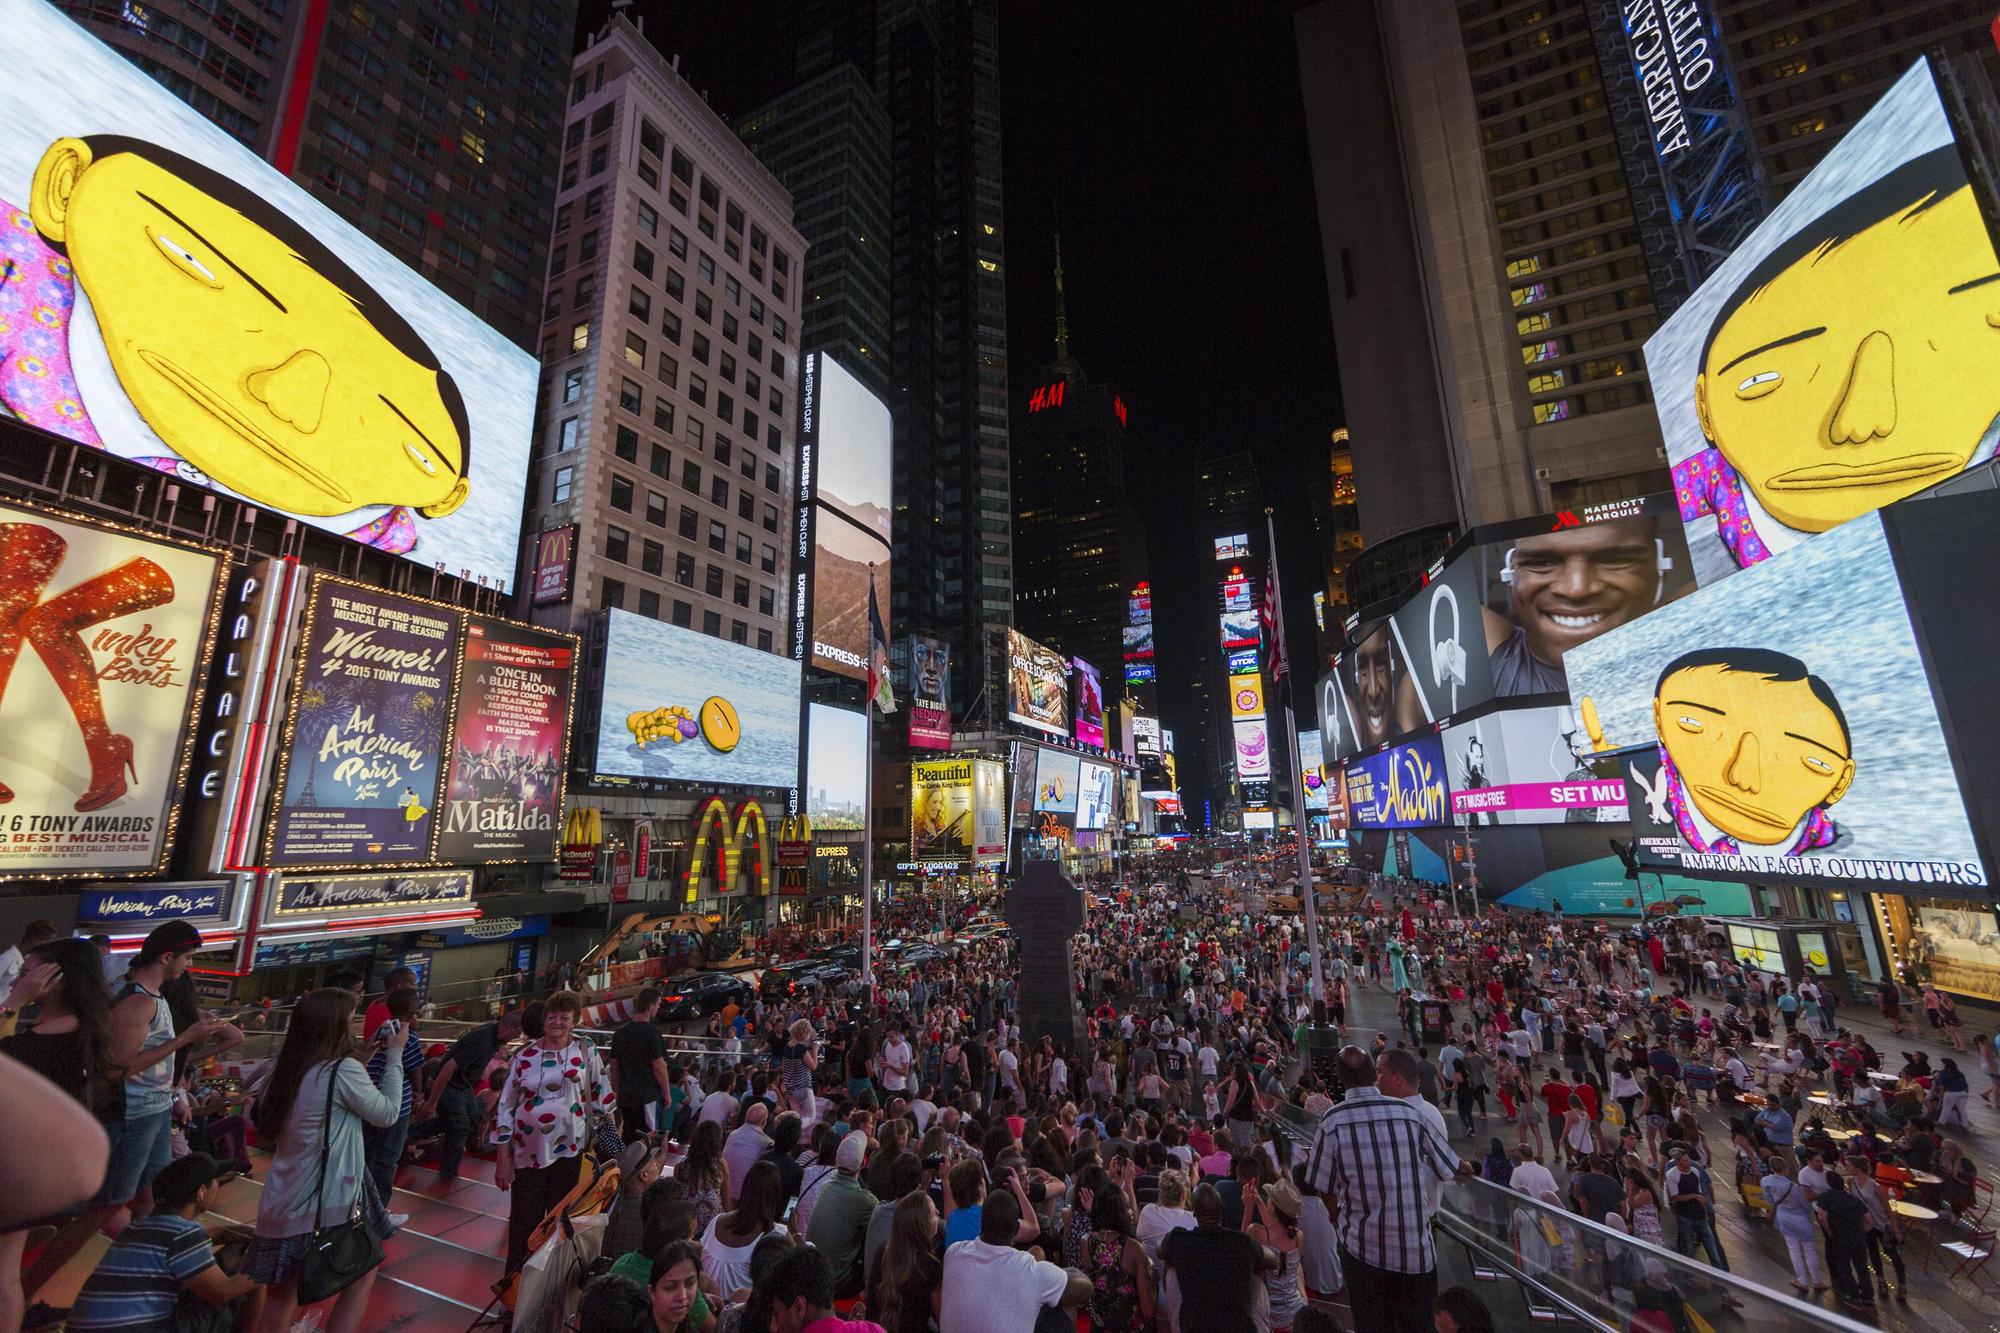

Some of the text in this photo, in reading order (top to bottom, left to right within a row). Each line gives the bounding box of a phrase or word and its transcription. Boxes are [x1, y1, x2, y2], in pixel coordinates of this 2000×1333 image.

[1624, 0, 1691, 156] AMERICAN
[1584, 498, 1646, 514] MARRIOTT
[1586, 507, 1640, 522] MARQUIS
[541, 564, 565, 576] OPEN
[542, 574, 560, 588] 24
[536, 586, 564, 598] HOURS
[331, 597, 448, 631] THE MOST AWARD-WINNING
[334, 609, 444, 640] MUSICAL OF THE SEASON!
[322, 627, 448, 672] Winner!
[490, 644, 550, 658] TIME Magazine's
[494, 654, 514, 662] Show
[524, 656, 536, 664] the
[538, 658, 554, 666] Year!
[1013, 655, 1034, 676] OFFICE
[96, 656, 184, 688] Boots
[320, 658, 441, 688] 4 2015 TONY AWARDS
[530, 672, 542, 682] IN
[202, 578, 256, 797] PALACE
[476, 675, 558, 696] A BLUE MOON.
[484, 694, 548, 709] OUT BLAZING AND
[497, 688, 519, 697] SHOW
[520, 692, 543, 700] COMES
[488, 703, 542, 716] RESTORES YOUR
[916, 699, 946, 711] TAYE DIGGS
[344, 705, 375, 735] An
[478, 708, 500, 716] FAITH
[510, 712, 550, 724] BROADWAY.
[498, 720, 530, 728] MATILDA
[495, 726, 515, 734] THAT
[318, 724, 424, 771] American
[333, 757, 402, 788] Paris
[917, 764, 971, 781] Beautiful
[942, 782, 953, 790] King
[1376, 748, 1444, 824] Aladdin
[1456, 790, 1506, 808] SET MUSIC FREE
[1550, 786, 1587, 803] SET
[11, 815, 154, 832] 6 TONY AWARDS
[444, 800, 553, 832] Matilda
[12, 834, 150, 842] BEST MUSICAL
[1640, 838, 1671, 846] AMERICAN
[562, 850, 594, 858] McDonald's
[816, 847, 848, 856] EXPRESS
[1682, 854, 1983, 885] AMERICAN EAGLE OUTFITTERS
[291, 880, 431, 906] An American Paris
[159, 895, 193, 914] Paris
[464, 922, 522, 933] MONEY EXCHANGE
[1168, 1059, 1180, 1070] 10
